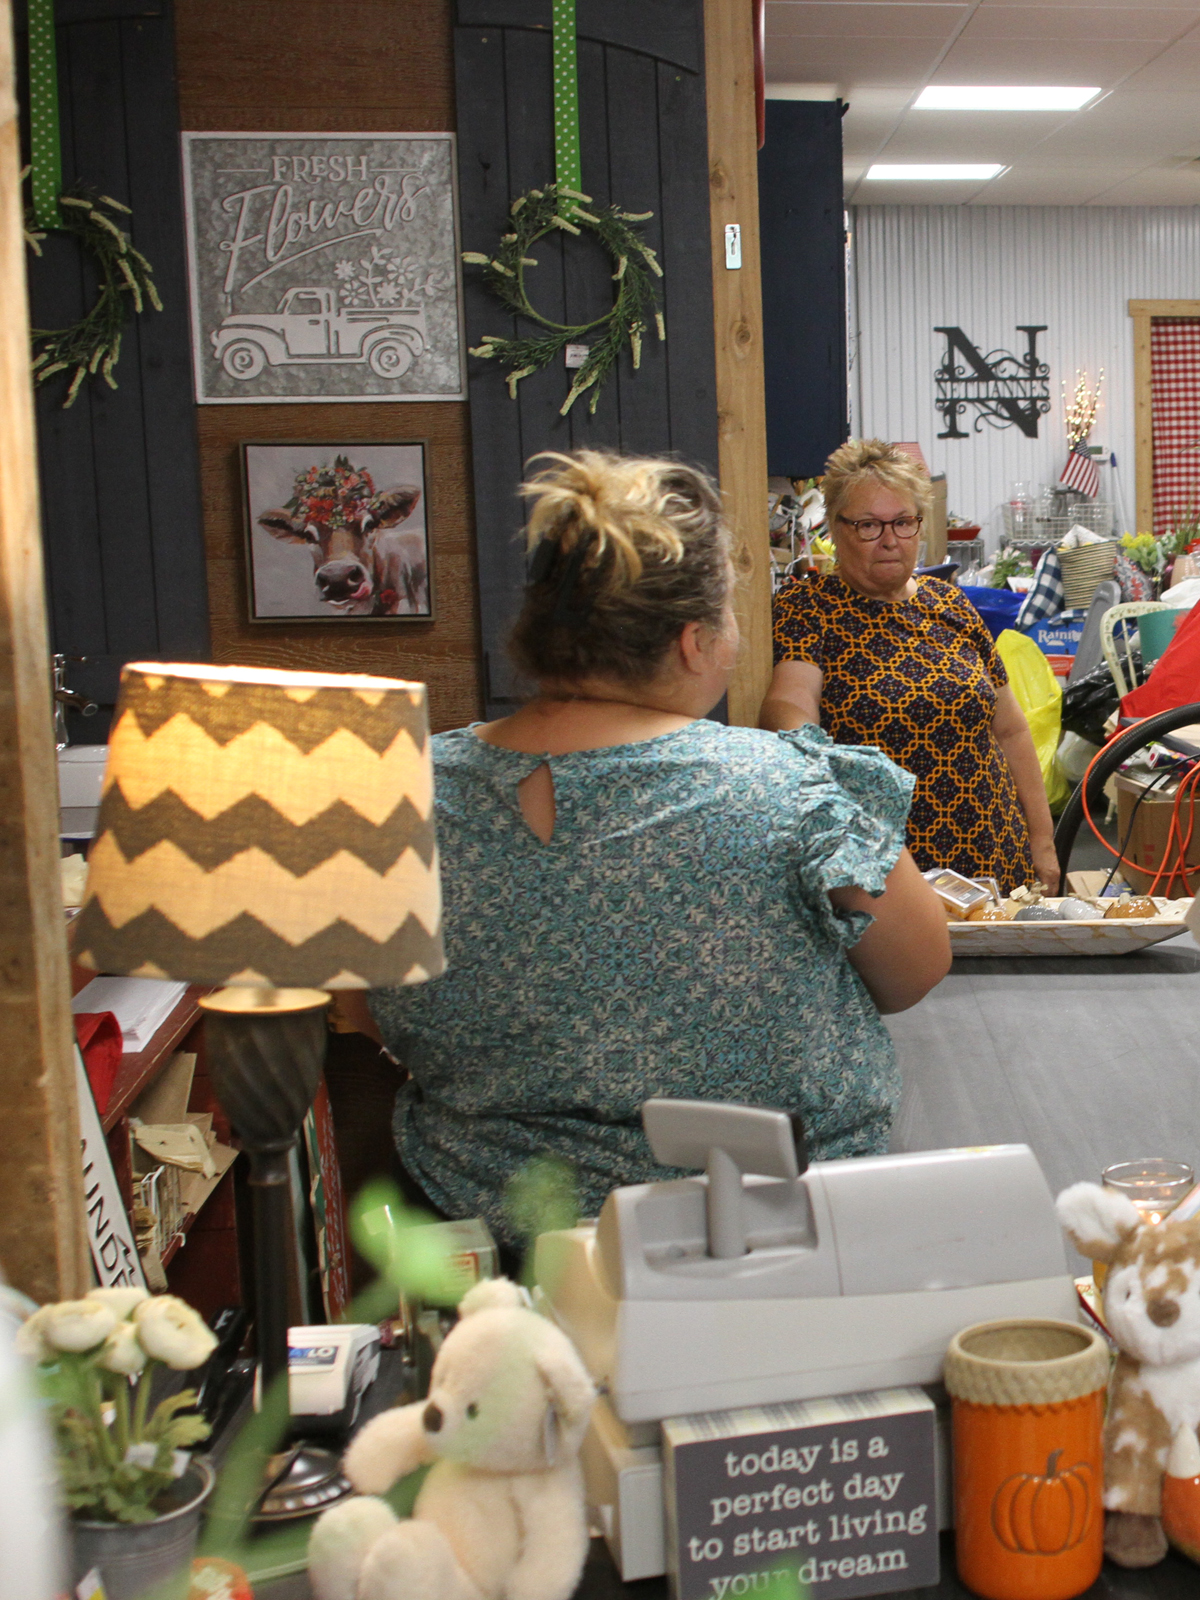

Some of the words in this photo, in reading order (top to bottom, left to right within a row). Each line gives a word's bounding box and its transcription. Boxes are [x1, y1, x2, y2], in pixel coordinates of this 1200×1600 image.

[272, 155, 369, 184] FRESH
[219, 173, 429, 293] Flowers
[725, 1444, 822, 1477] today
[829, 1437, 859, 1464] is
[867, 1435, 889, 1459] a
[710, 1478, 834, 1526] perfect
[843, 1472, 905, 1501] day
[688, 1536, 724, 1562] to
[733, 1519, 821, 1556] start
[828, 1503, 928, 1542] living
[708, 1565, 791, 1600] your
[798, 1548, 908, 1585] dream
